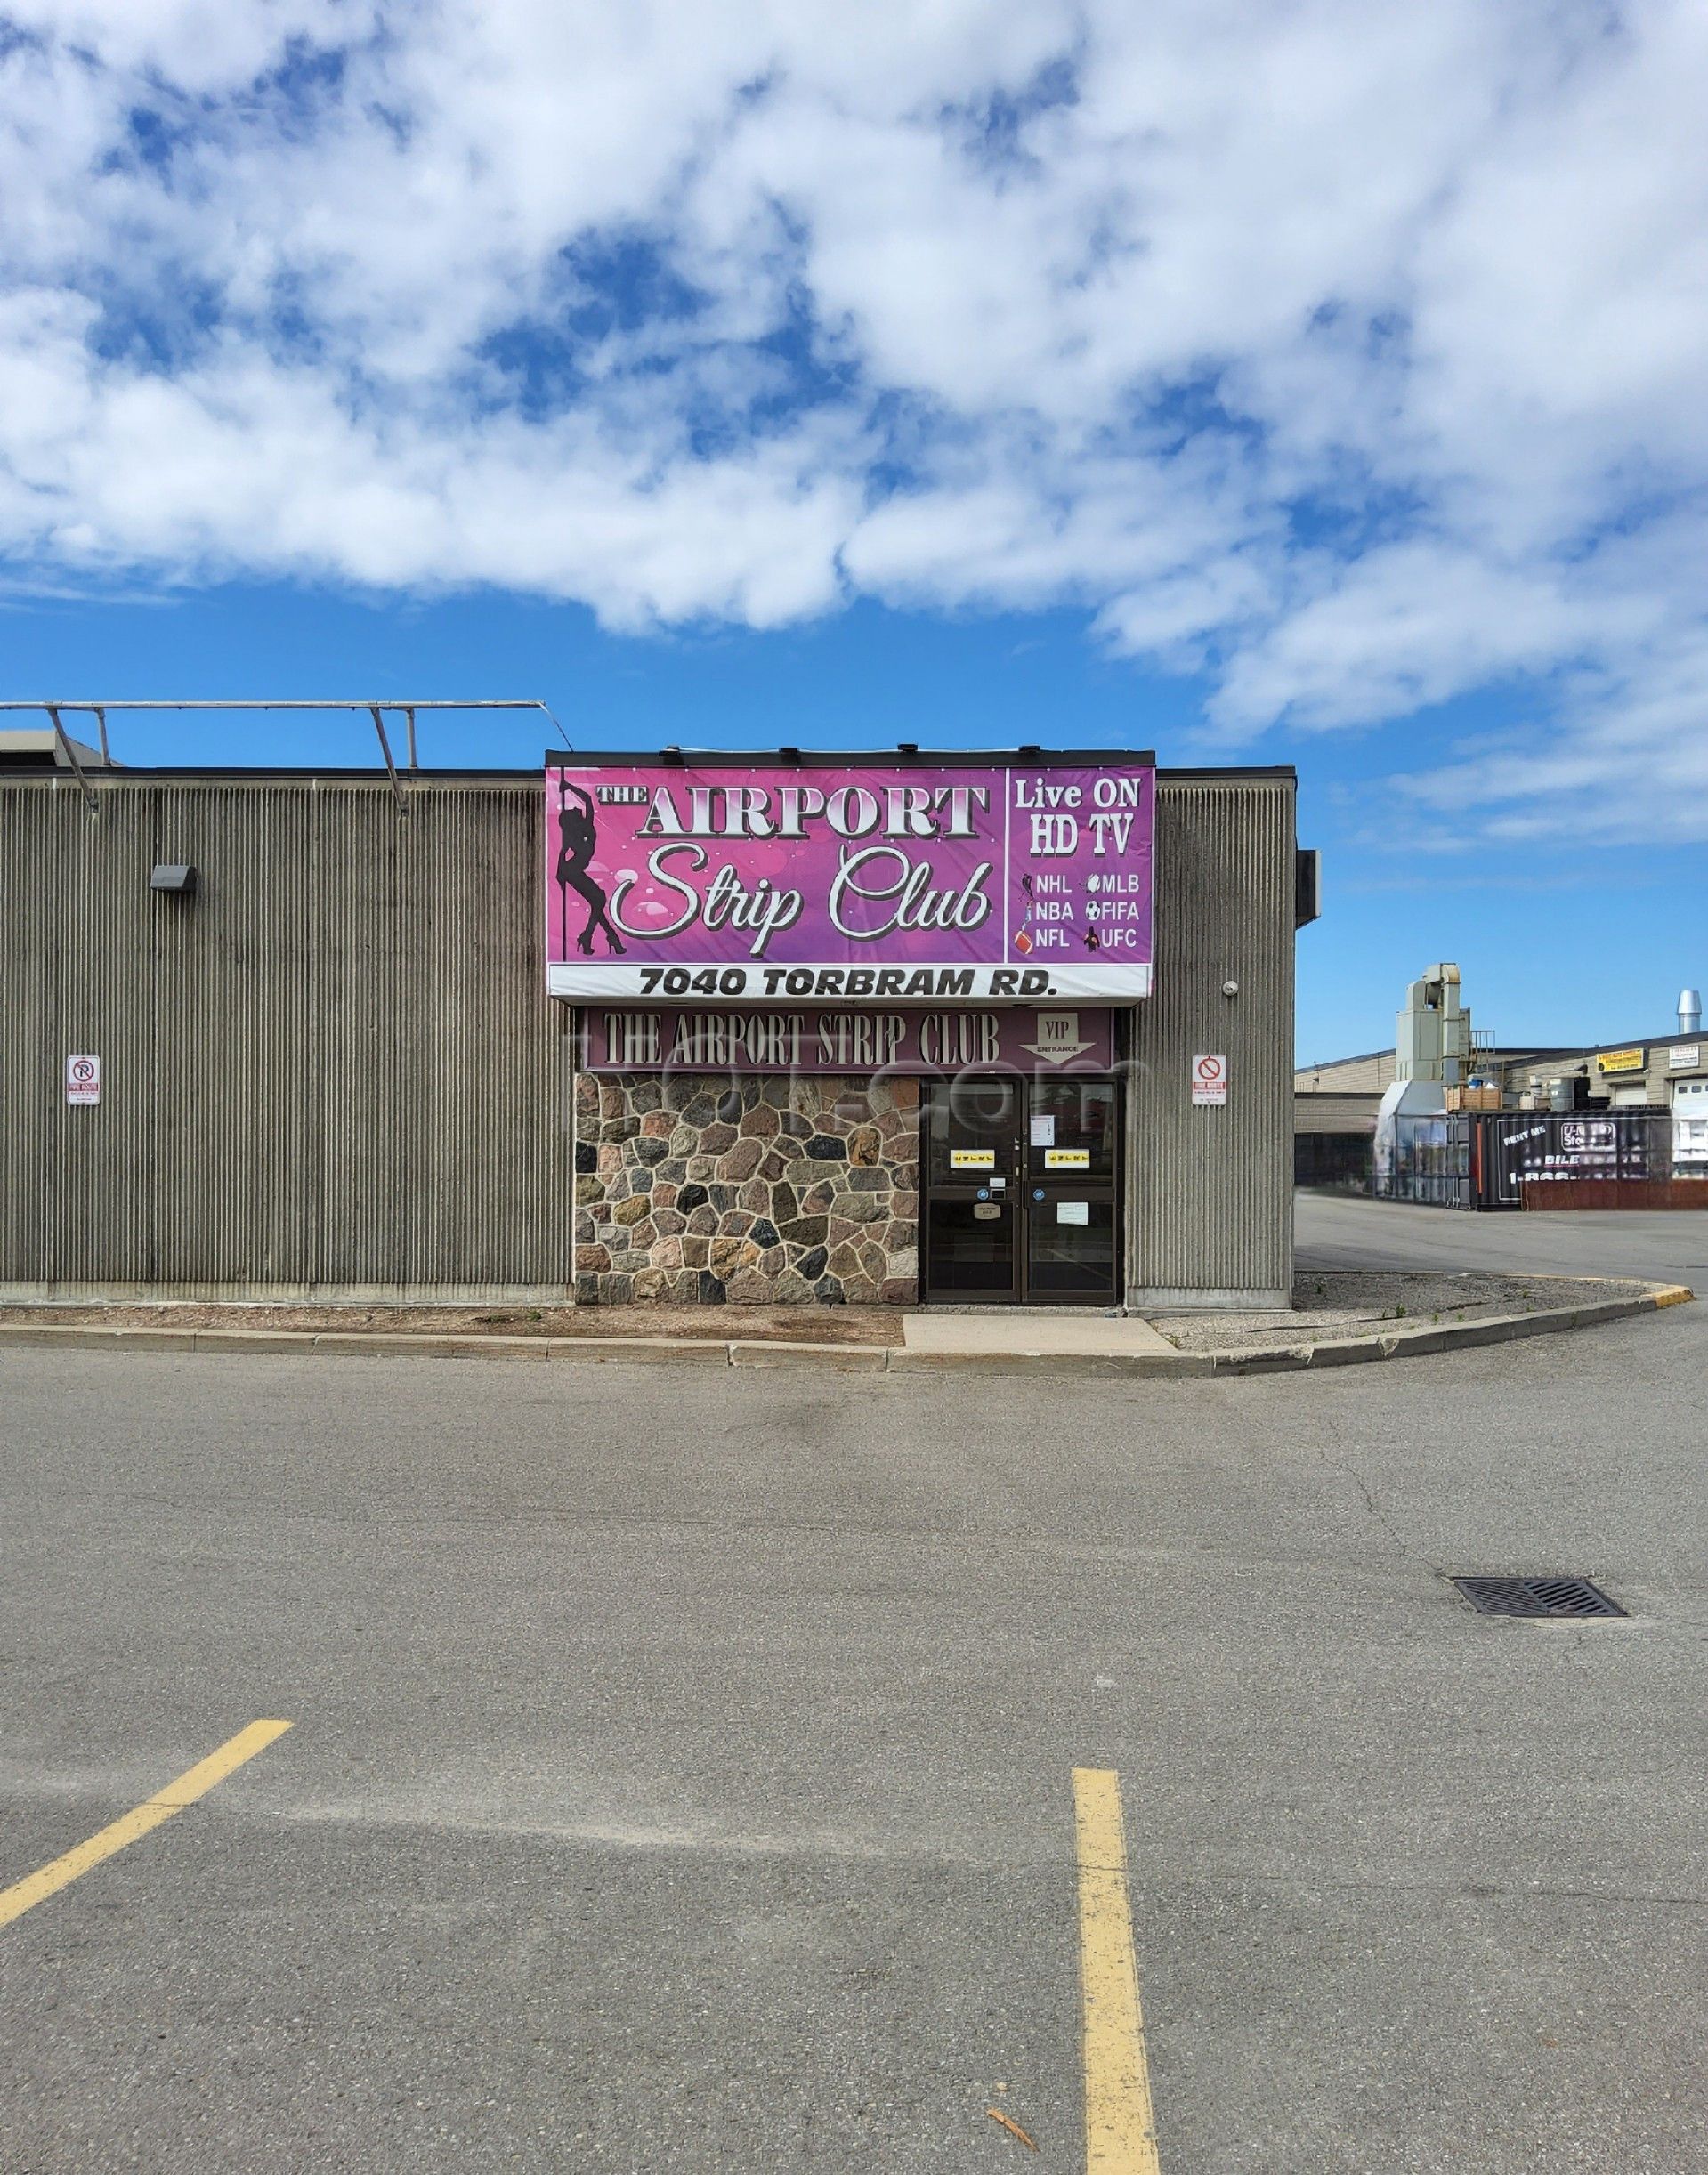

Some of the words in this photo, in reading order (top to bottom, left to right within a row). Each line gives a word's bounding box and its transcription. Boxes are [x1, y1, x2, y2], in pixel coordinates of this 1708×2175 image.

[1015, 778, 1082, 808] Live
[1093, 777, 1141, 808] ON
[596, 786, 648, 804] THE
[635, 786, 989, 838] AIRPORT
[1030, 813, 1078, 857] HD
[1089, 813, 1134, 857] TV
[1035, 874, 1072, 893] NHL
[1102, 874, 1139, 893] MLB
[609, 842, 804, 958] Strip
[829, 844, 993, 942] Club
[1035, 902, 1074, 920] NBA
[1102, 902, 1139, 920] FIFA
[1035, 929, 1069, 947] NFL
[1102, 929, 1137, 947] UFC
[639, 968, 747, 996] 7040
[763, 968, 976, 996] TORBRAM
[989, 968, 1058, 996] RD.
[603, 1013, 662, 1064] THE
[671, 1013, 805, 1065] AIRPORT
[817, 1013, 907, 1066] STRIP
[919, 1013, 1000, 1065] CLUB
[1046, 1021, 1069, 1039] VIP
